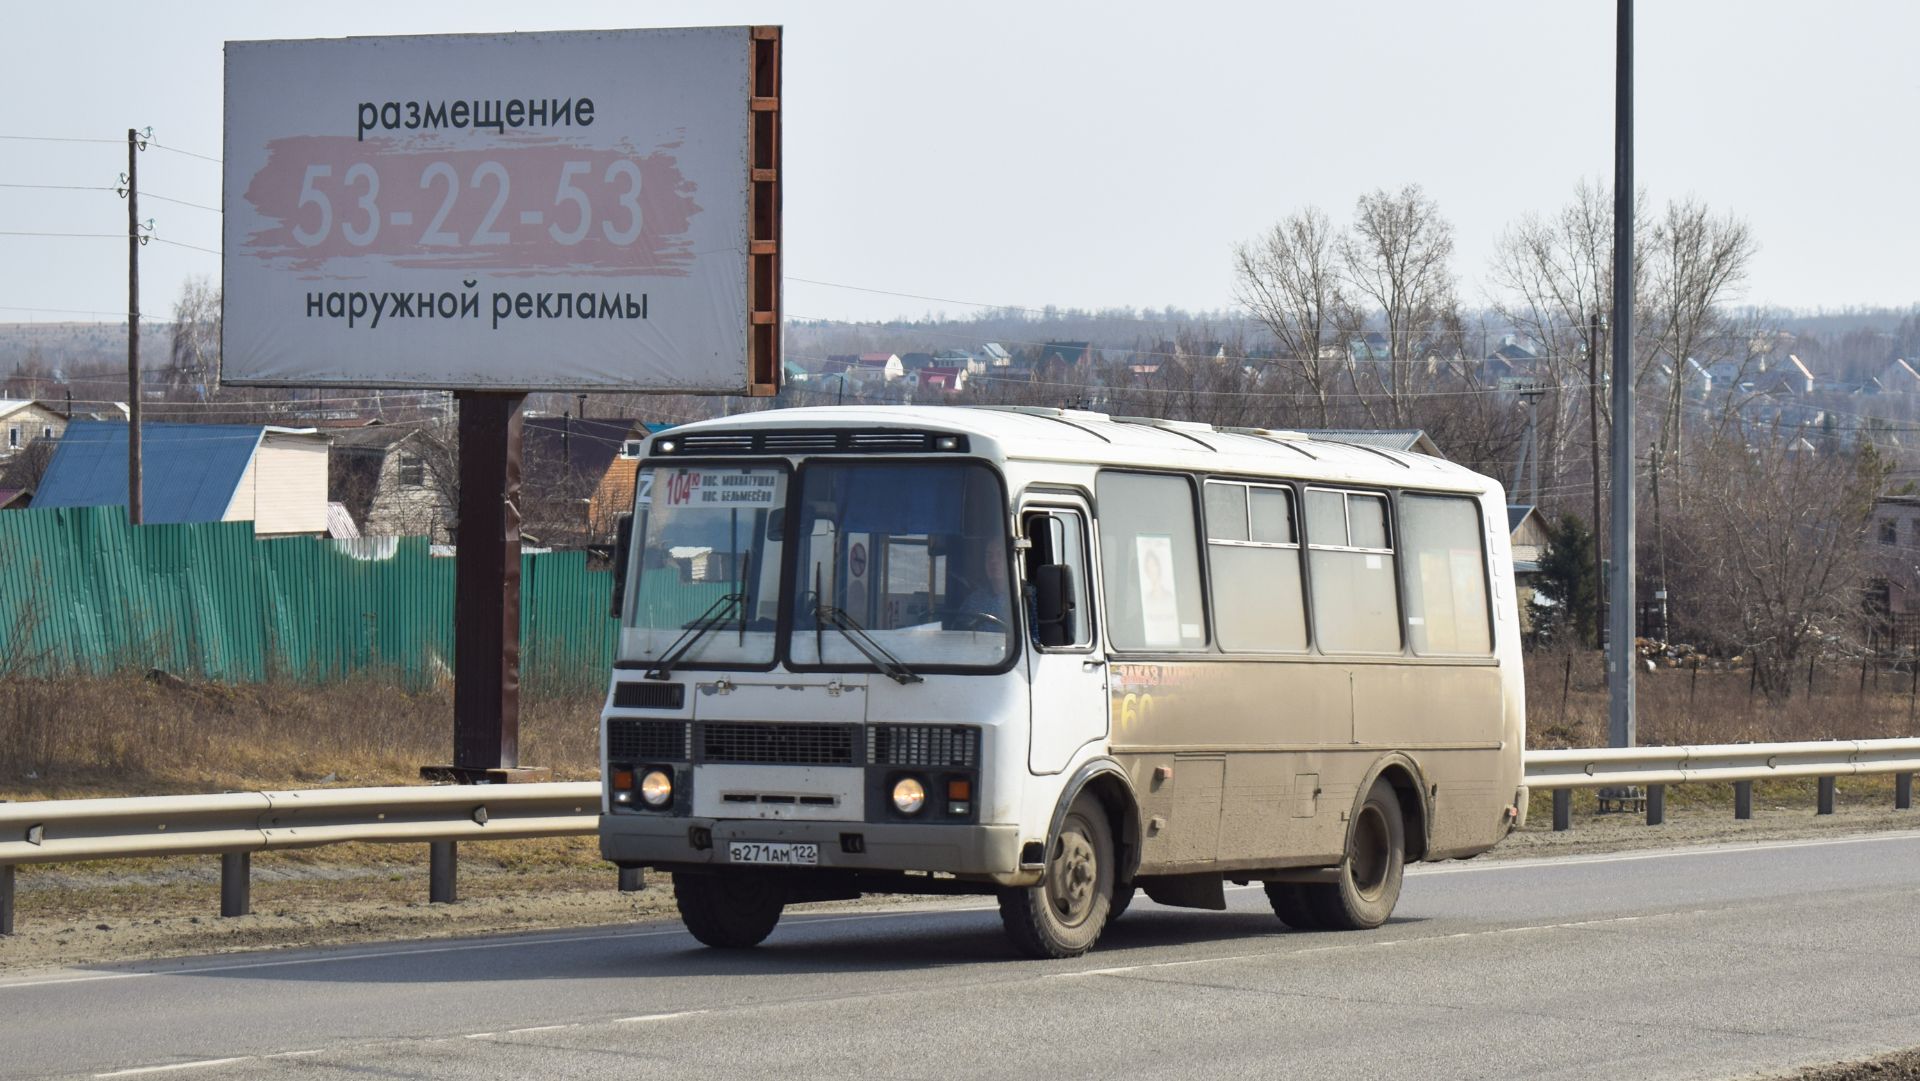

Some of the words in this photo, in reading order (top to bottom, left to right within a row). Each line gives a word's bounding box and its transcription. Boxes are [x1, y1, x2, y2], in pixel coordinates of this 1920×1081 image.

[357, 97, 595, 142] размещение
[291, 158, 644, 248] 53-22-53
[306, 279, 479, 329] наружной
[491, 291, 648, 330] рекламы
[792, 845, 814, 859] 122
